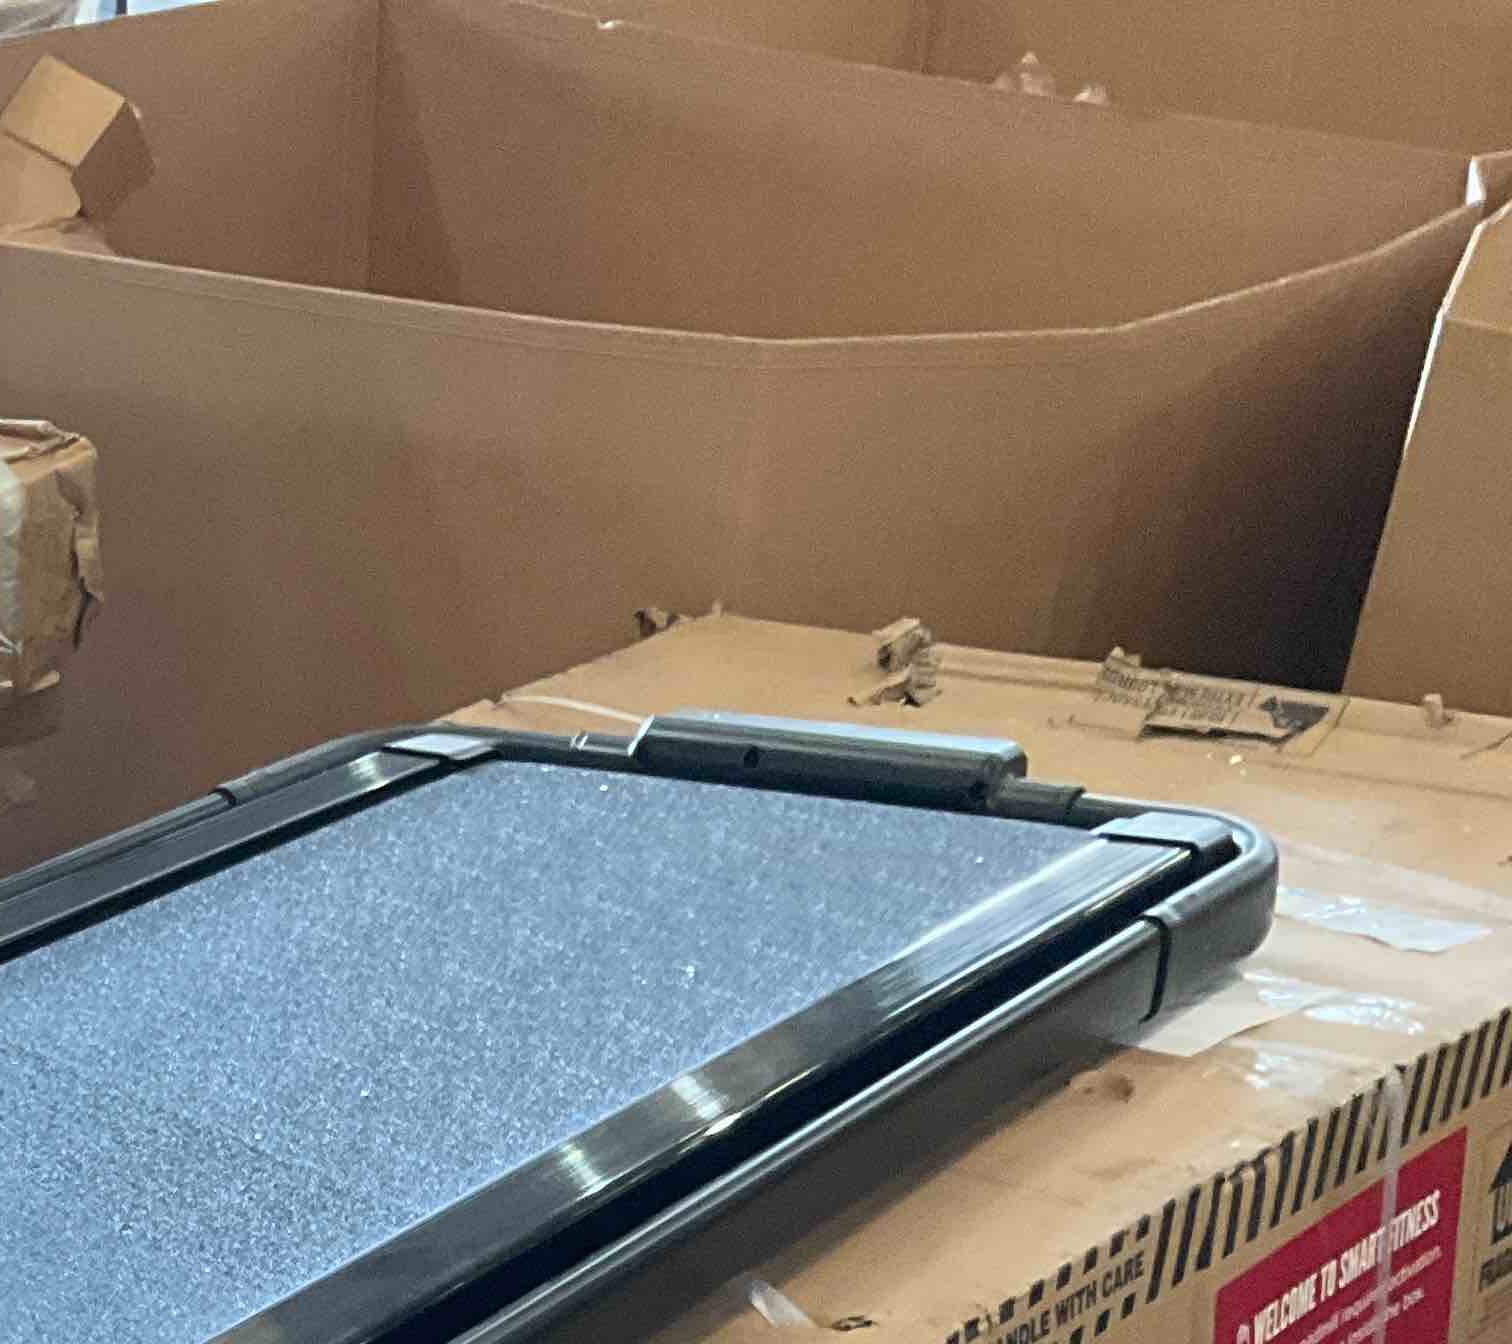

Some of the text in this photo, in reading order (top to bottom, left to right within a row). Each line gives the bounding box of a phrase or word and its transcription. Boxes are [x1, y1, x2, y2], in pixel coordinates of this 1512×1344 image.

[1054, 1284, 1099, 1328] WITH
[1101, 1250, 1145, 1303] CARE
[1319, 1258, 1338, 1303] TO
[1337, 1225, 1386, 1290] SMART
